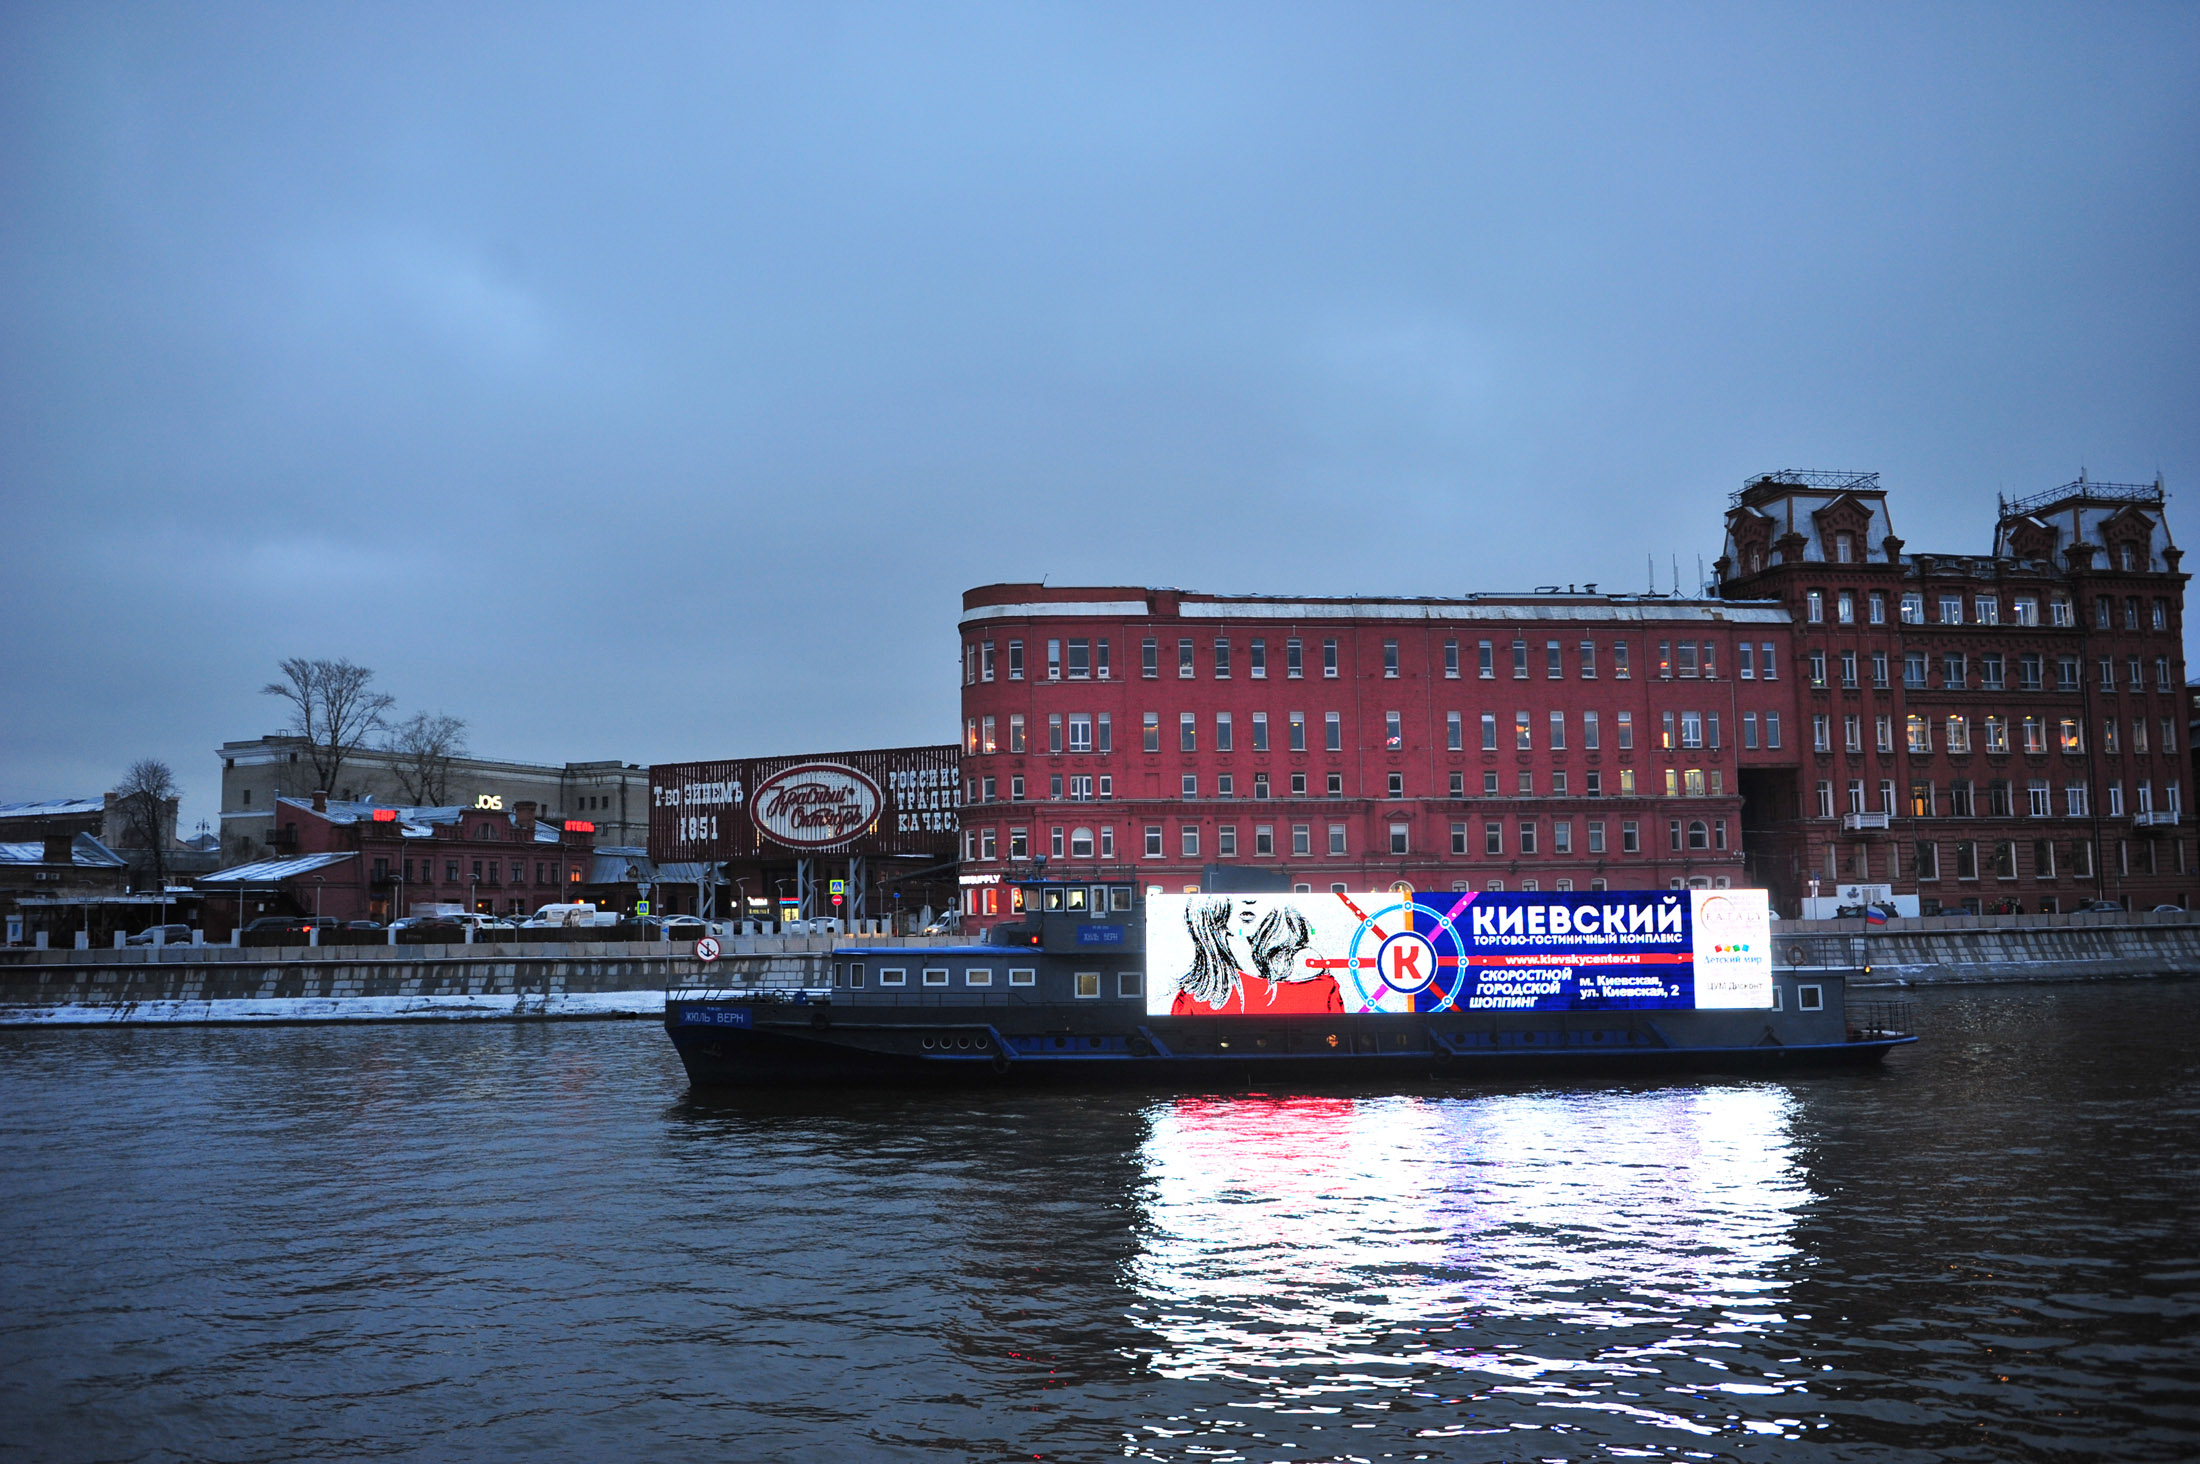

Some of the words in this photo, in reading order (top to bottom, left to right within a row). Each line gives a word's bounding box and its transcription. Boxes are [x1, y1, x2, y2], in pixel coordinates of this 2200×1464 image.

[684, 781, 744, 805] ЭЙНЕМЪ
[767, 783, 846, 817] Красный
[372, 809, 397, 822] БАР
[791, 804, 863, 836] Октябрь
[564, 820, 595, 833] ОТЕЛЬ
[680, 816, 718, 841] 1851
[1472, 896, 1683, 935] КИЕВСКИЙ
[1474, 931, 1617, 946] ТОРГОВО-ГОСТИНИЧНЫЙ
[1619, 933, 1683, 944] КОМПЛЕКС
[1505, 954, 1641, 966] www.kievskycenter.ru
[1479, 967, 1572, 982] СКОРОСТНОЙ
[1579, 977, 1595, 987] м.
[1597, 975, 1663, 988] Киевская,
[1476, 981, 1561, 996] ГОРОДСКОЙ
[1579, 988, 1600, 1000] ул.
[1603, 985, 1669, 999] Киевская,
[1670, 985, 1680, 997] 2
[1469, 996, 1539, 1009] ШОППИНГ
[685, 1012, 711, 1023] ЖЮЛЬ
[717, 1012, 744, 1024] ВЕРН
